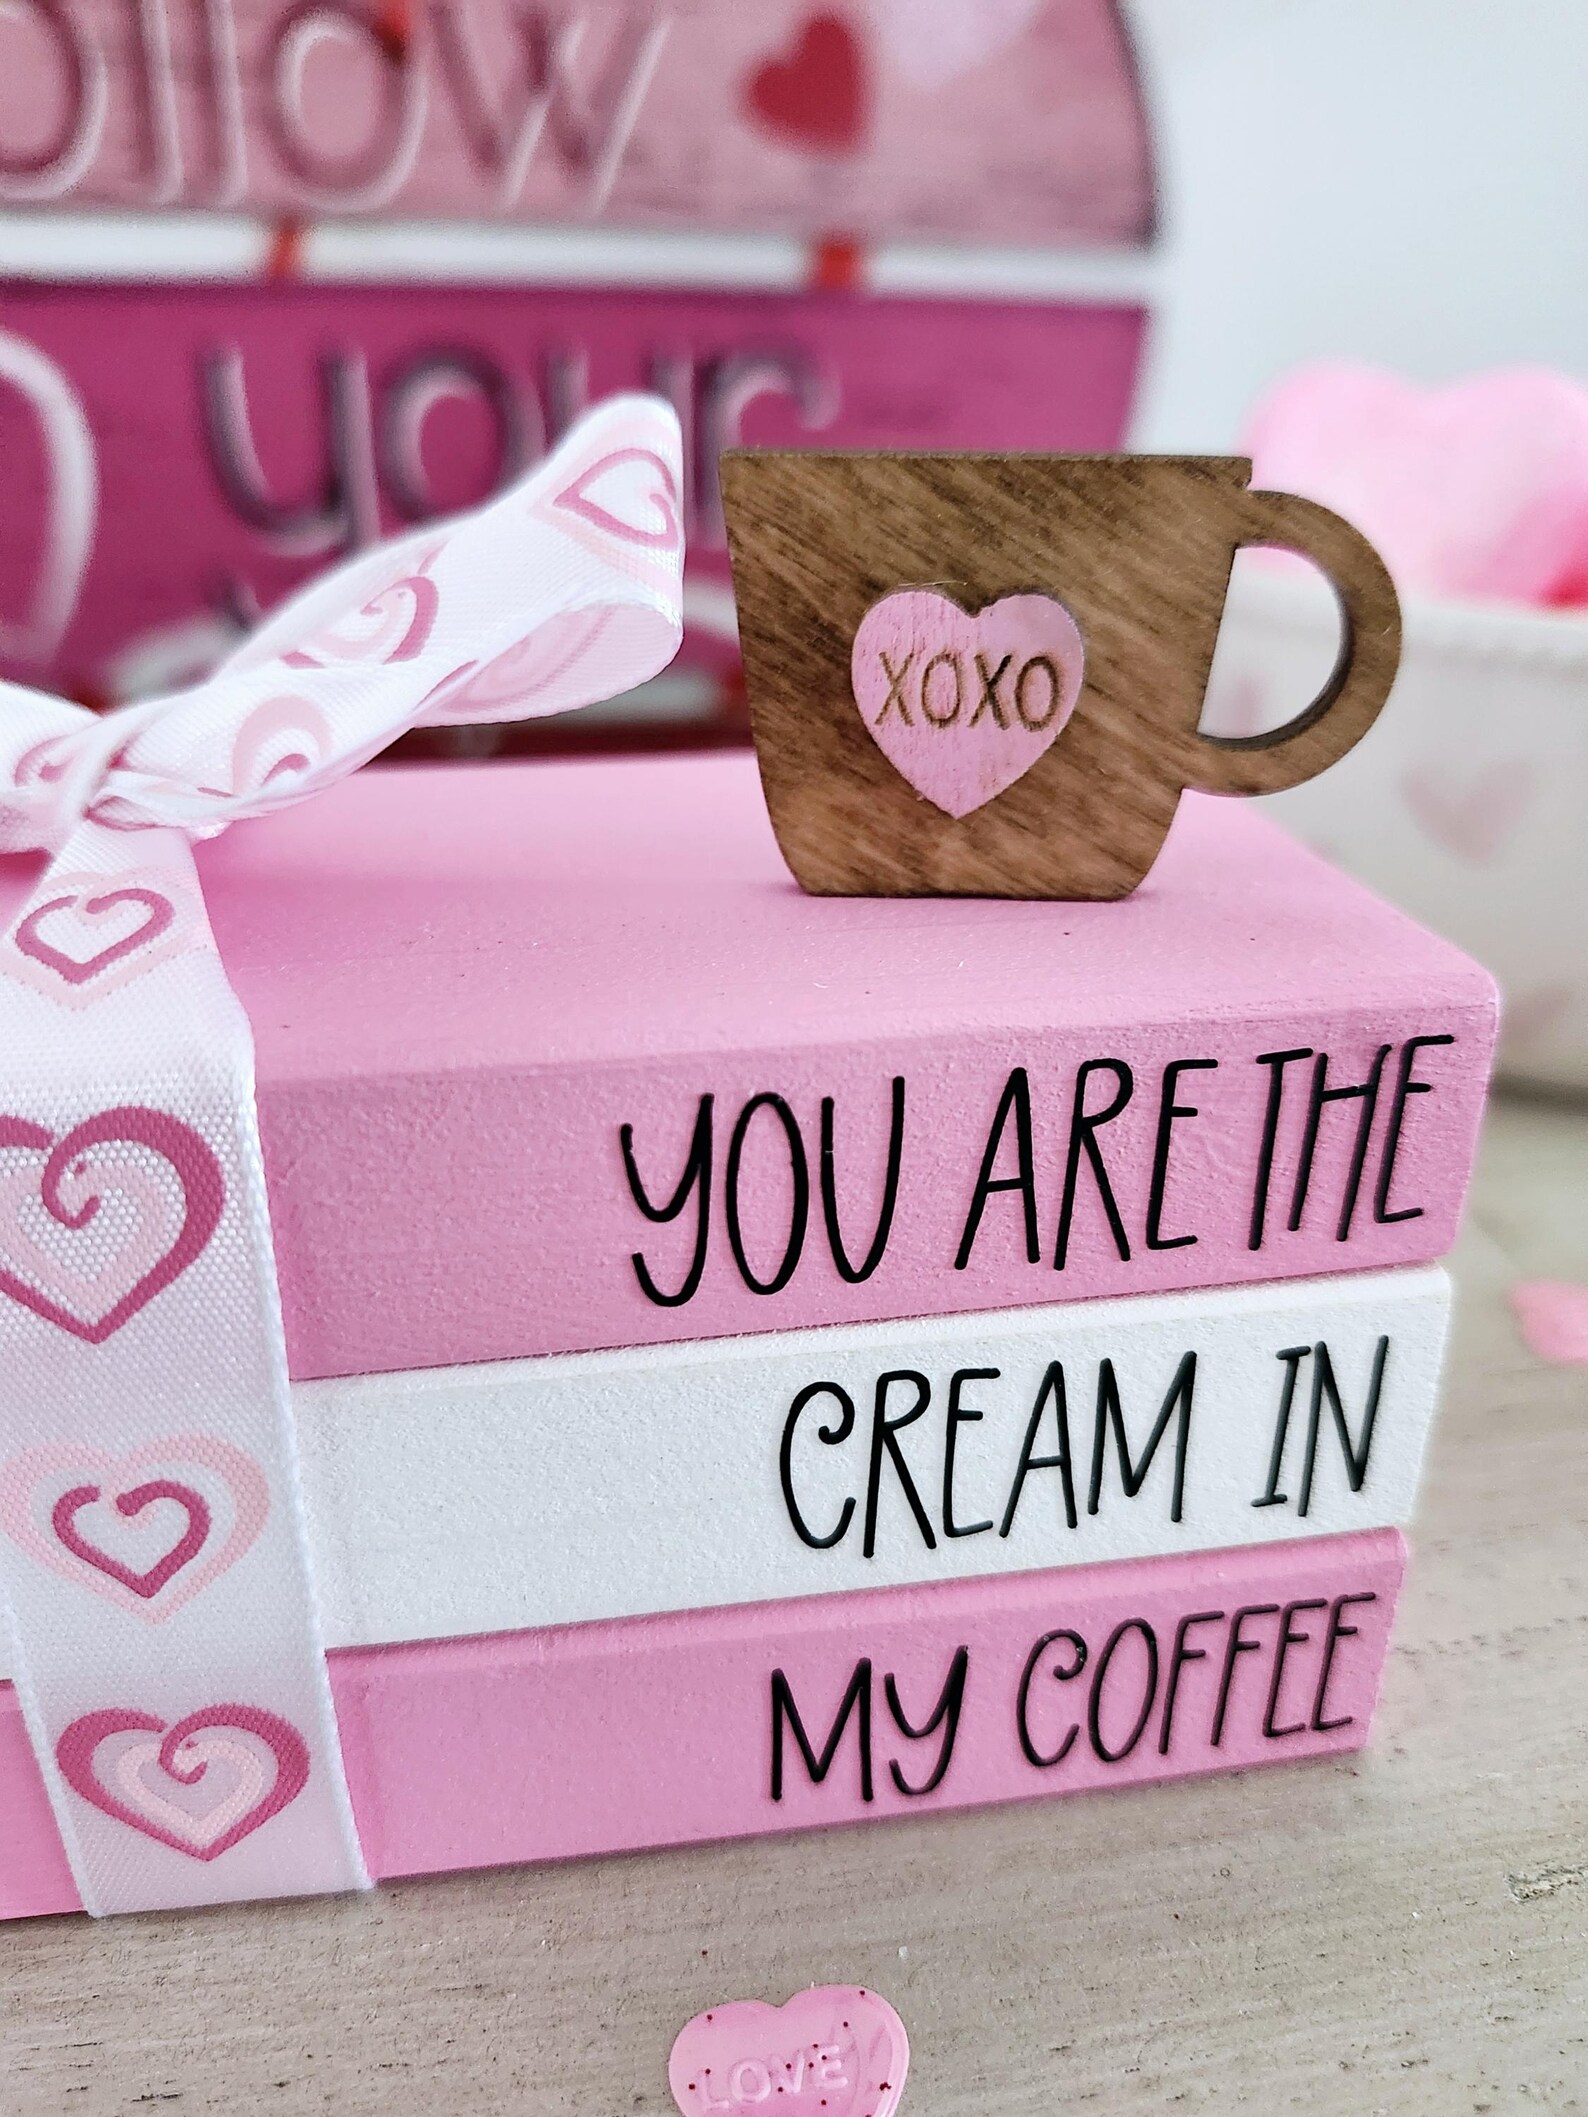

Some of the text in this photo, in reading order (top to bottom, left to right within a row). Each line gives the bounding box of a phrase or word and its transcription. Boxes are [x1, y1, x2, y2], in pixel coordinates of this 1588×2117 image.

[874, 650, 1060, 733] XOXO
[619, 1034, 1457, 1308] YOU ARE THE
[779, 1335, 1390, 1559] CREAM IN
[769, 1591, 1377, 1804] MY COFFEE
[701, 2043, 849, 2111] LOVE
